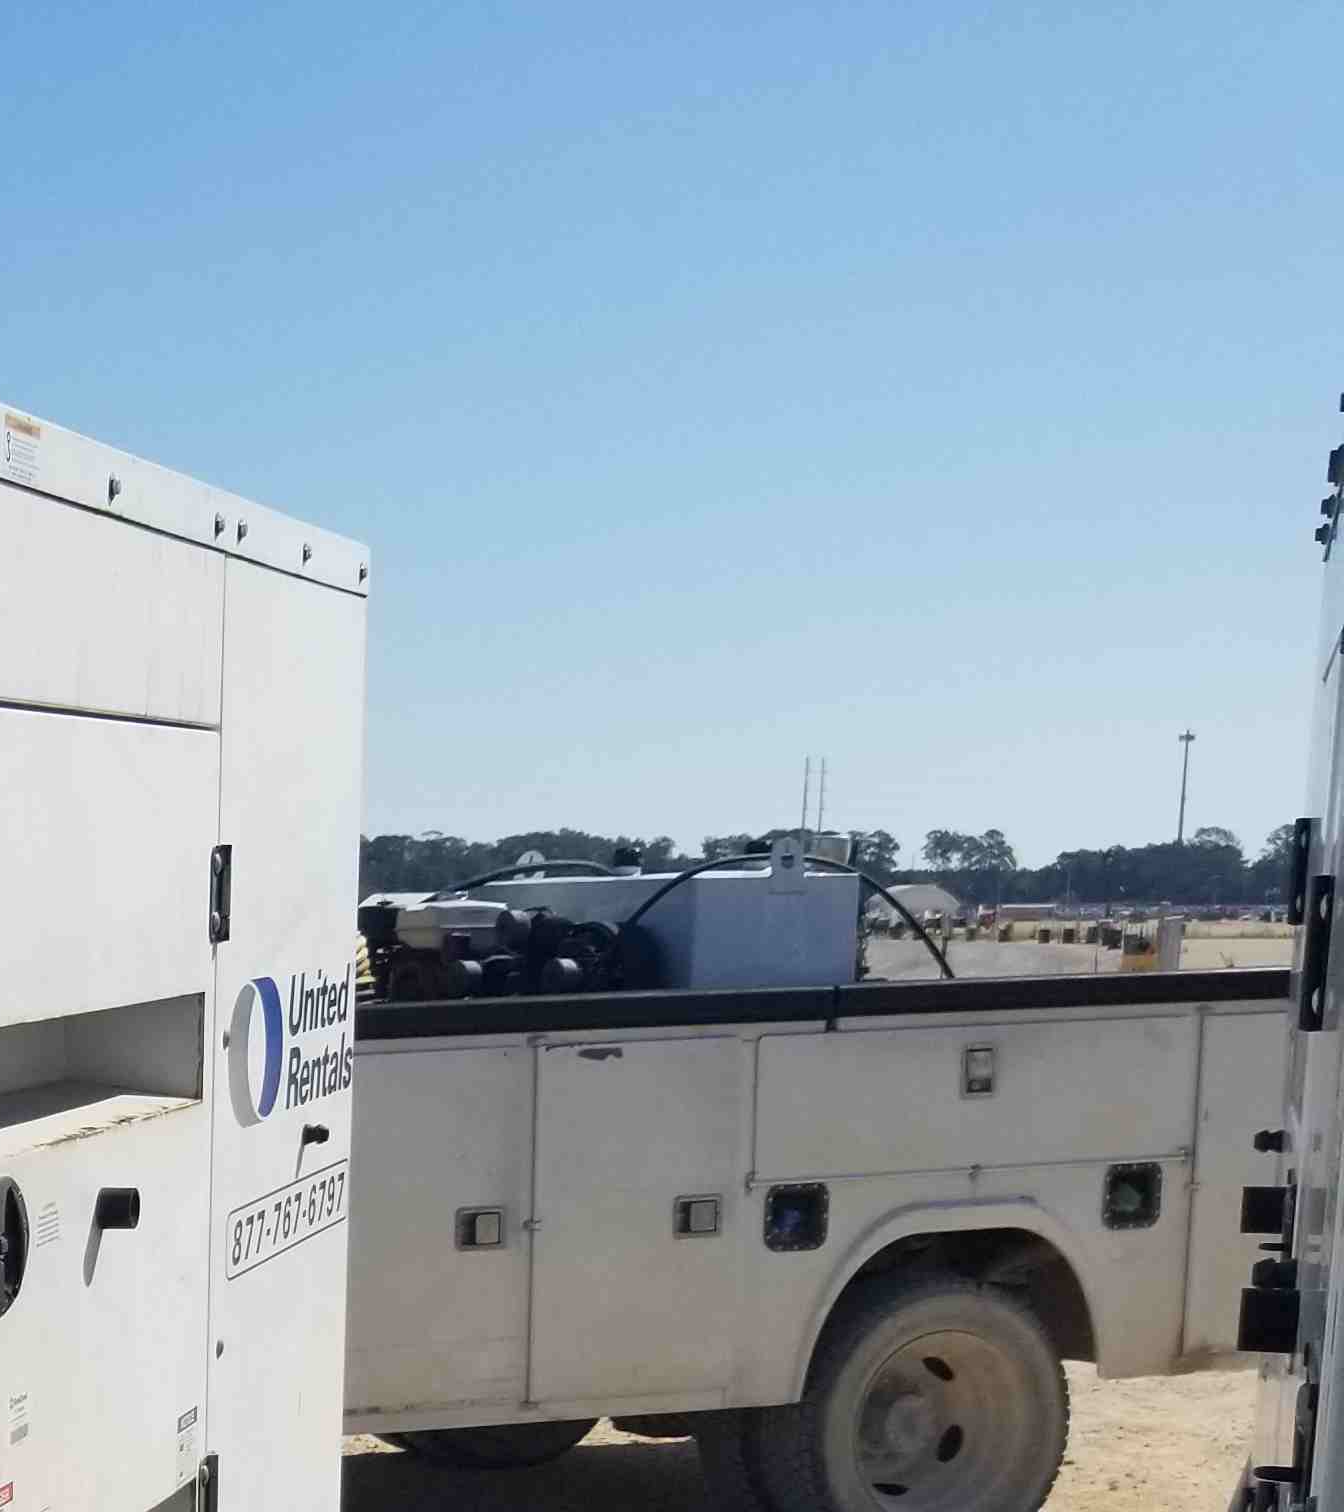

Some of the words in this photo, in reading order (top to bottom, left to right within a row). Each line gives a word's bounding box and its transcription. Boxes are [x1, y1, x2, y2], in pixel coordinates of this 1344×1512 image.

[287, 962, 351, 1037] United
[285, 1031, 353, 1111] Rentals
[231, 1171, 346, 1267] 877-767-6797
